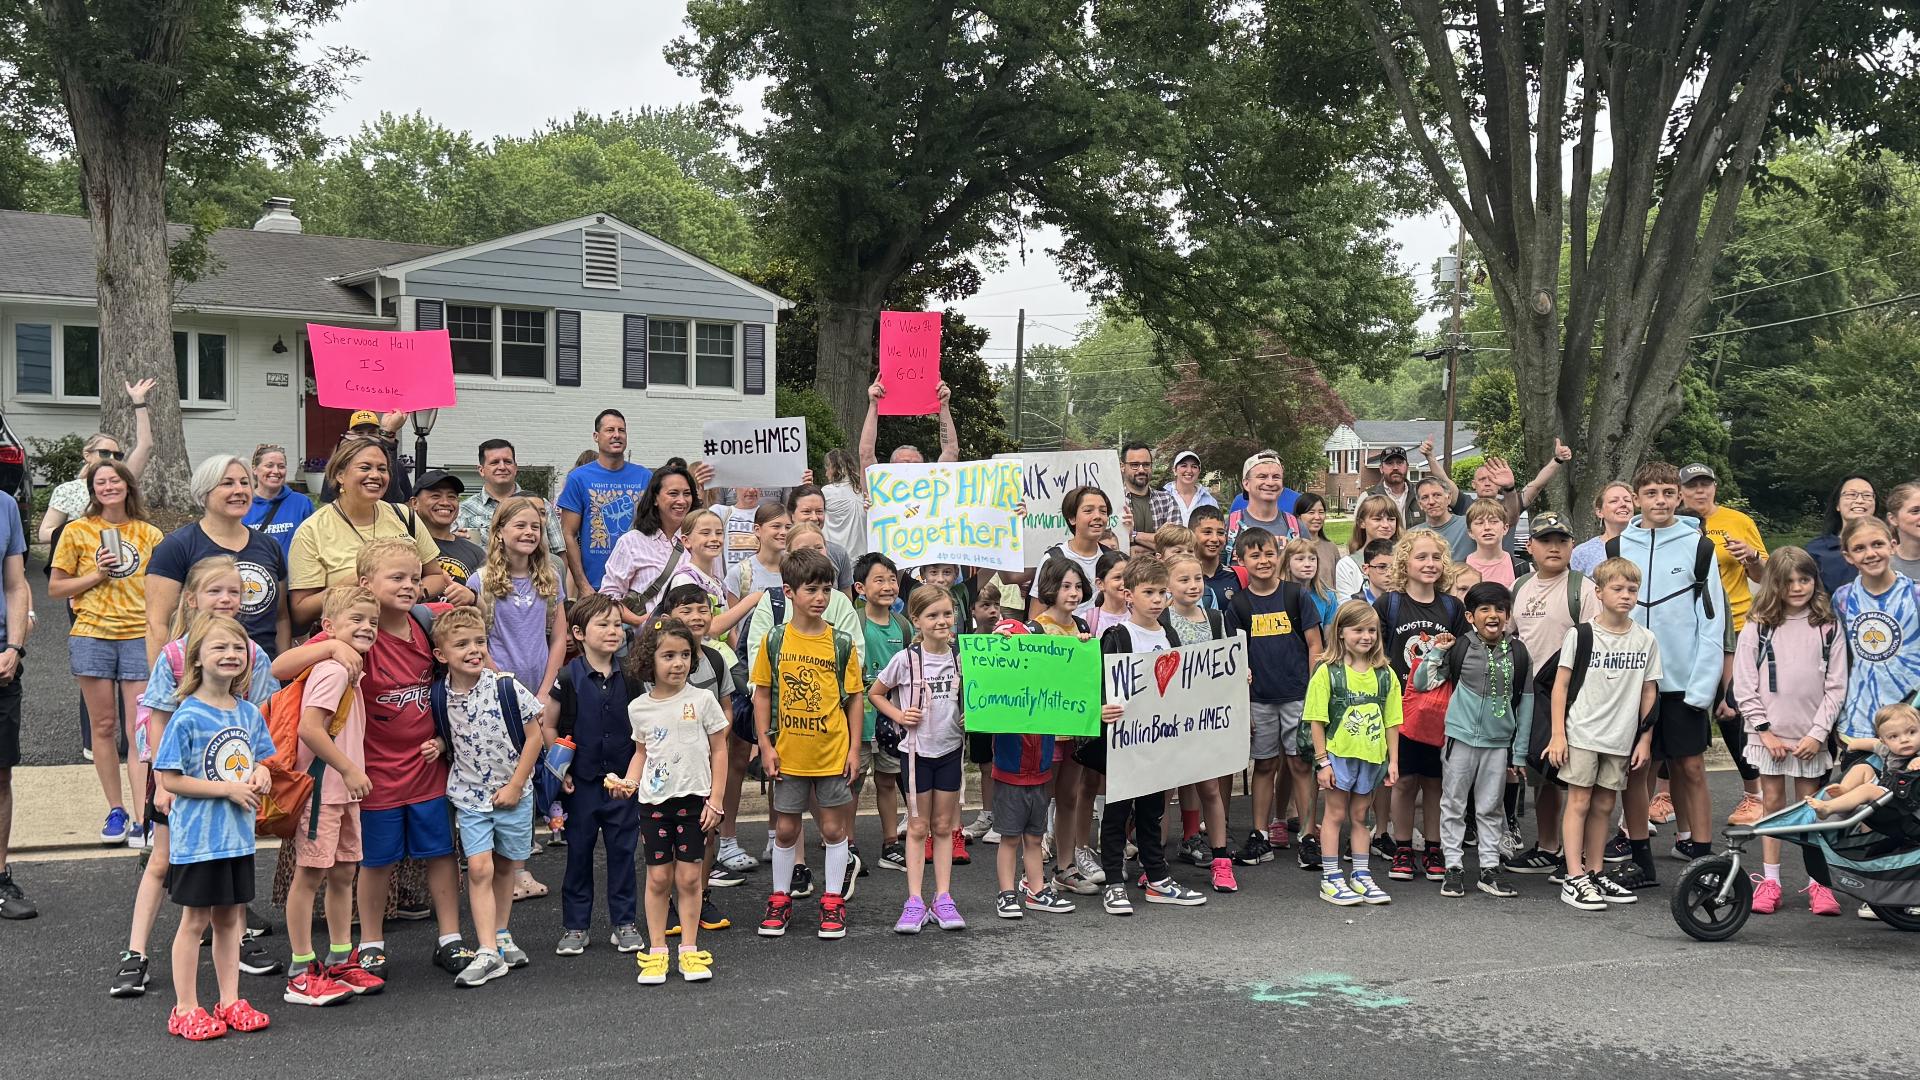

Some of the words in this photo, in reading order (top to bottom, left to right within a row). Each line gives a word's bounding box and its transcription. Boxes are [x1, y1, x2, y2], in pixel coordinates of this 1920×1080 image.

[323, 331, 379, 348] Sherwood
[390, 336, 415, 351] Hall
[359, 359, 386, 372] IS
[896, 367, 924, 381] GO!
[345, 379, 404, 397] Crossable
[703, 426, 801, 457] #oneHMES
[867, 472, 949, 517] Keep
[956, 463, 1022, 510] HMES
[870, 514, 1019, 558] Together!
[1396, 620, 1434, 635] MONSTER
[962, 636, 1011, 652] FCPS
[1018, 638, 1075, 663] boundary
[1602, 651, 1647, 670] ANGELES
[971, 653, 1029, 670] review:
[1111, 655, 1147, 701] WE
[1181, 641, 1242, 690] HMES
[1184, 716, 1195, 733] to
[1198, 705, 1232, 731] HMES
[208, 731, 231, 757] HOLLIN
